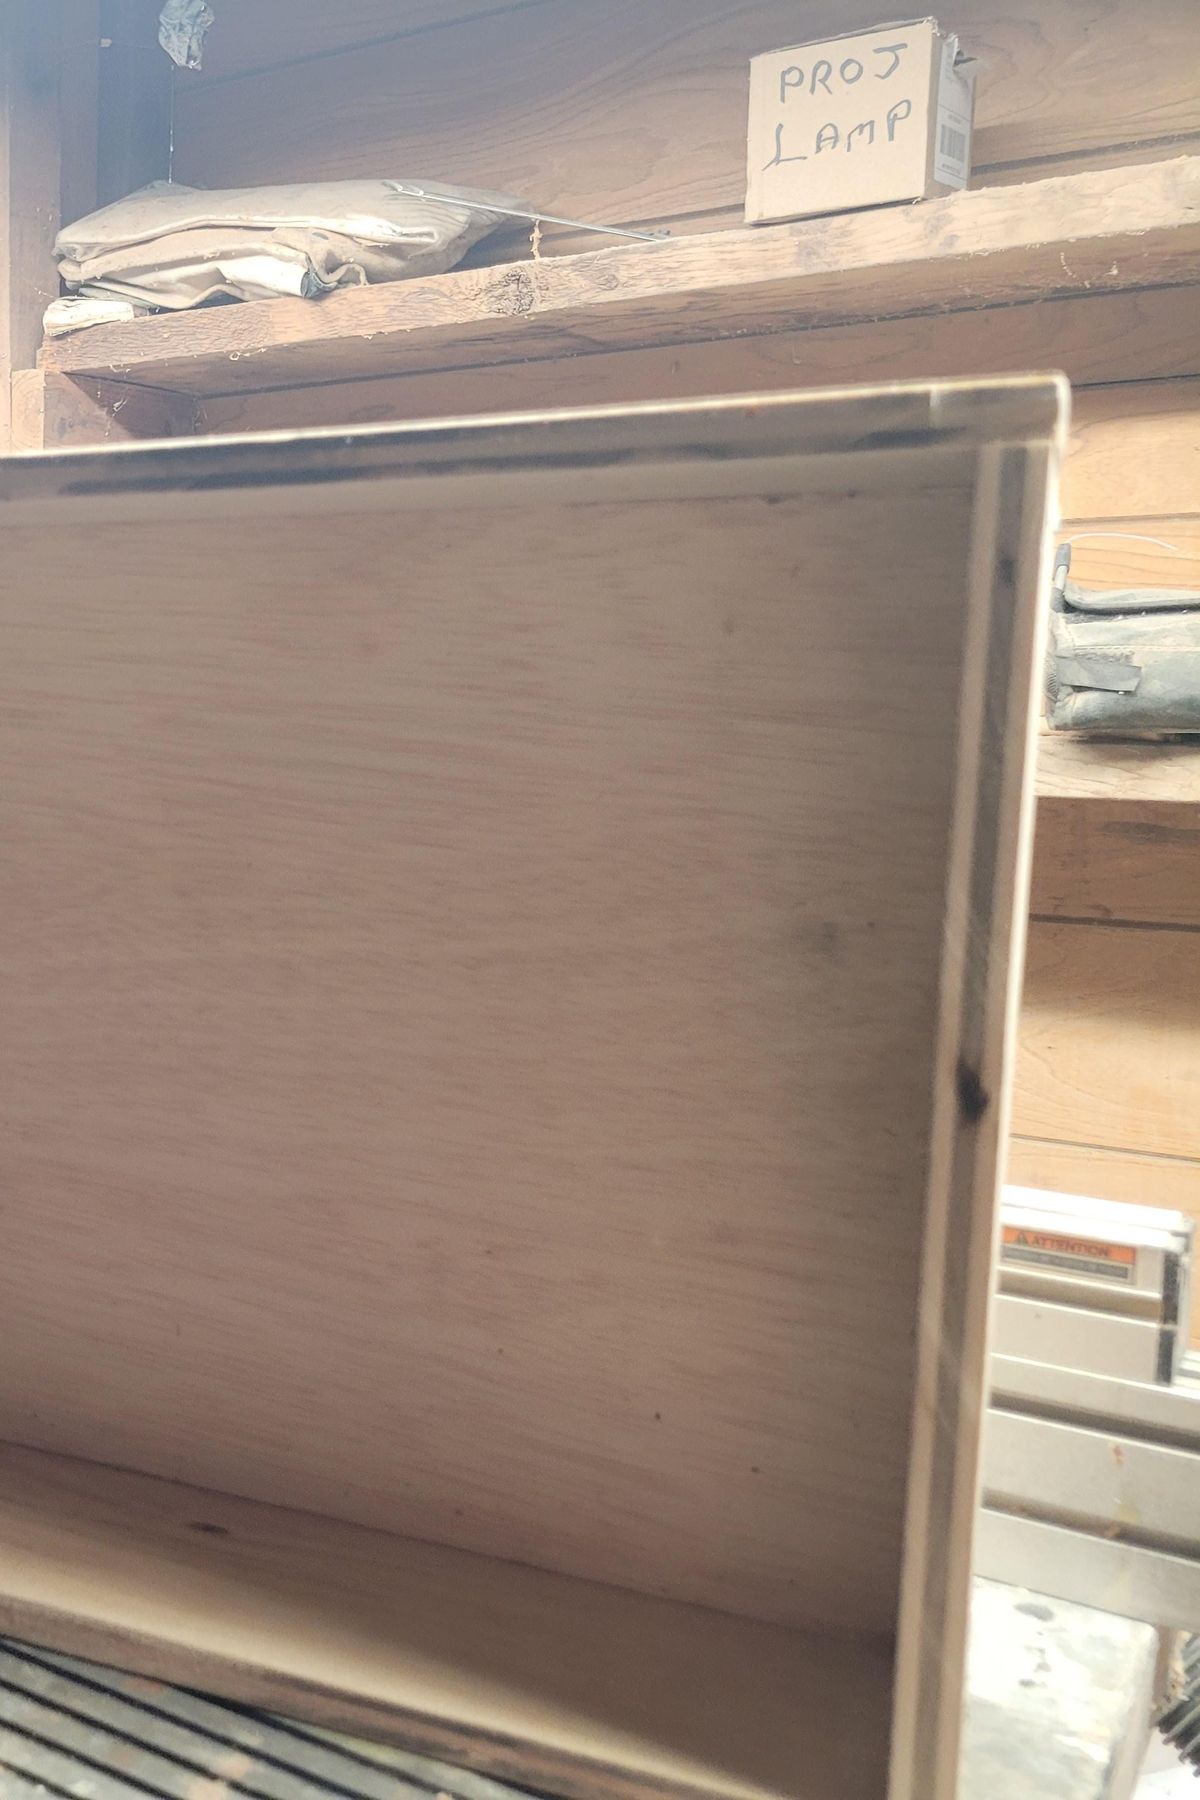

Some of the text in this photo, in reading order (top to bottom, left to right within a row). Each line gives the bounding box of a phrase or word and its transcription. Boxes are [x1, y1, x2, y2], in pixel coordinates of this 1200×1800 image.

[779, 43, 908, 104] PROJ
[761, 99, 912, 172] LAMP
[1033, 1232, 1110, 1257] ATTENTION
